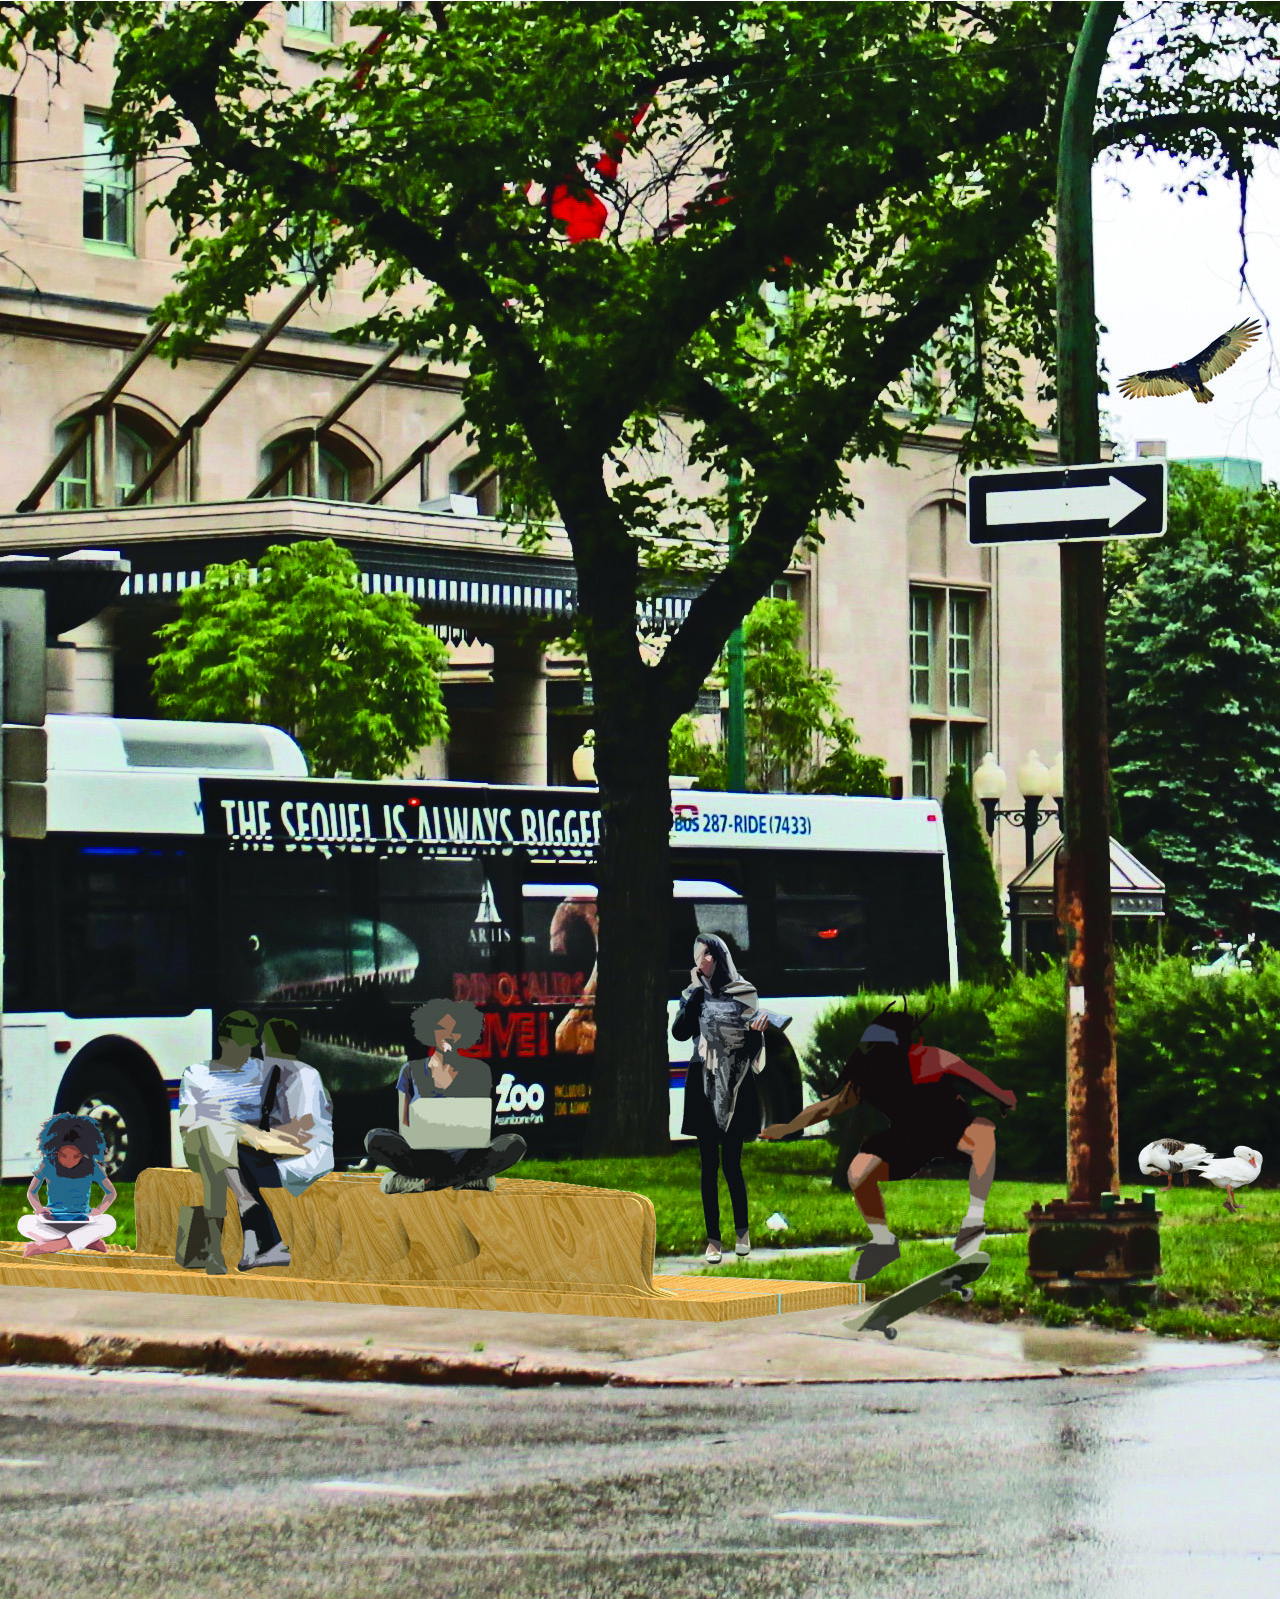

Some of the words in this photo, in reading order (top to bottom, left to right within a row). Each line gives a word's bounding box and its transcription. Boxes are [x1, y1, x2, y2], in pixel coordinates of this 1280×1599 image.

[220, 799, 274, 852] THE
[280, 800, 376, 860] SEQUEL
[382, 804, 411, 856] IS
[417, 805, 514, 857] ALWAYS
[702, 813, 767, 834] 287-RIDE
[769, 815, 812, 836] (7433)
